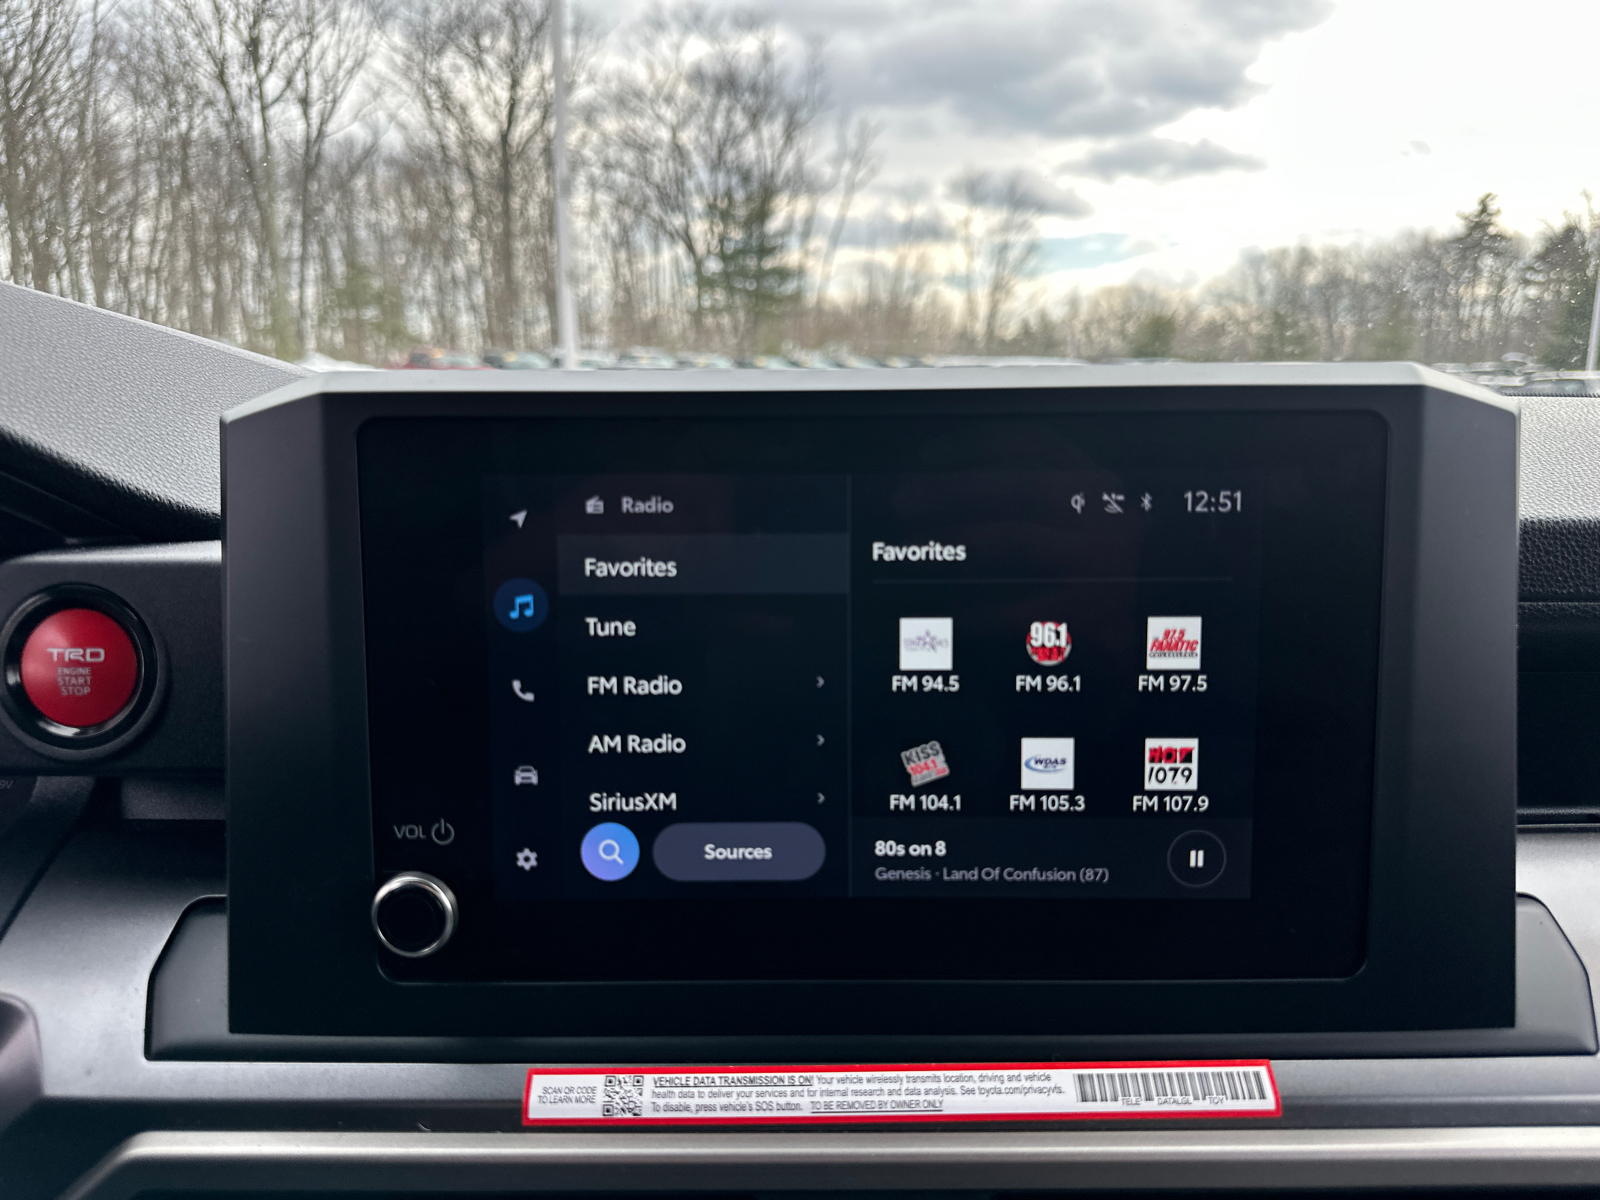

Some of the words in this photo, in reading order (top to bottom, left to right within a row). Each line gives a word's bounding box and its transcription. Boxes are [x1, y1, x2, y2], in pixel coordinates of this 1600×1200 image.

[621, 496, 675, 514] Radio
[1183, 490, 1243, 513] 12:51
[871, 540, 967, 562] Favorites
[584, 557, 678, 578] Favorites
[586, 617, 637, 637] Tune
[1030, 621, 1068, 648] 96.1
[47, 648, 105, 662] TRD
[57, 667, 92, 675] ENGINE
[57, 676, 92, 685] START
[587, 676, 618, 695] FM
[623, 675, 683, 695] Radio
[892, 675, 918, 692] FM
[922, 675, 960, 692] 94.5
[1015, 675, 1042, 692] FM
[1046, 675, 1081, 692] 96.1
[1138, 675, 1165, 692] FM
[1169, 675, 1208, 692] 97.5
[61, 686, 91, 695] STOP
[588, 735, 622, 753] AM
[627, 734, 687, 753] Radio
[904, 742, 941, 766] KISS
[1148, 745, 1195, 764] HOT
[589, 793, 677, 812] SiriusXM
[889, 794, 915, 811] FM
[919, 794, 962, 811] 104.1
[1009, 795, 1036, 811] FM
[1040, 795, 1086, 812] 105.3
[1132, 796, 1159, 812] FM
[1163, 796, 1209, 812] 107.9
[393, 825, 427, 839] VOL
[704, 843, 773, 860] Sources
[874, 840, 905, 857] 80s
[909, 844, 932, 857] on
[935, 841, 947, 857] 8
[875, 867, 931, 882] Genesis
[943, 867, 978, 882] Land
[981, 866, 1000, 882] Of
[1003, 866, 1076, 882] Confusion
[1079, 867, 1110, 884] (87)
[653, 1076, 691, 1087] VEHICLE
[693, 1076, 716, 1086] DATA
[718, 1075, 786, 1085] TRANSMISSION
[787, 1075, 796, 1085] IS
[798, 1075, 814, 1085] ON!
[817, 1075, 834, 1085] Your
[836, 1074, 864, 1084] vehicle
[866, 1074, 904, 1086] wirelessly
[905, 1073, 942, 1083] transmits
[943, 1073, 976, 1084] location,
[978, 1072, 1004, 1084] driving
[1007, 1073, 1022, 1082] and
[1024, 1072, 1051, 1082] vehicle
[542, 1086, 563, 1095] SCAN
[577, 1086, 597, 1095] CODE
[652, 1089, 676, 1099] health
[678, 1089, 695, 1099] data
[697, 1089, 706, 1098] to
[708, 1089, 733, 1098] deliver
[735, 1090, 753, 1100] your
[755, 1088, 788, 1098] services
[790, 1088, 805, 1097] and
[806, 1087, 818, 1097] for
[819, 1087, 849, 1097] internal
[851, 1086, 885, 1096] research
[887, 1086, 902, 1096] and
[904, 1085, 922, 1096] data
[923, 1085, 958, 1097] analysis.
[960, 1085, 976, 1095] See
[538, 1096, 548, 1104] TO
[549, 1095, 573, 1104] LEARN
[574, 1095, 596, 1104] MORE
[651, 1102, 661, 1112] To
[662, 1101, 693, 1113] disable,
[695, 1103, 717, 1114] press
[719, 1101, 753, 1111] vehicle's
[756, 1101, 774, 1111] SOS
[776, 1100, 803, 1111] button.
[811, 1100, 822, 1110] TO
[823, 1100, 834, 1110] BE
[836, 1100, 877, 1110] REMOVED
[878, 1100, 888, 1109] BY
[891, 1100, 921, 1109] OWNER
[923, 1099, 944, 1109] ONLY
[1121, 1097, 1141, 1105] TELE
[1207, 1095, 1223, 1104] TOY
